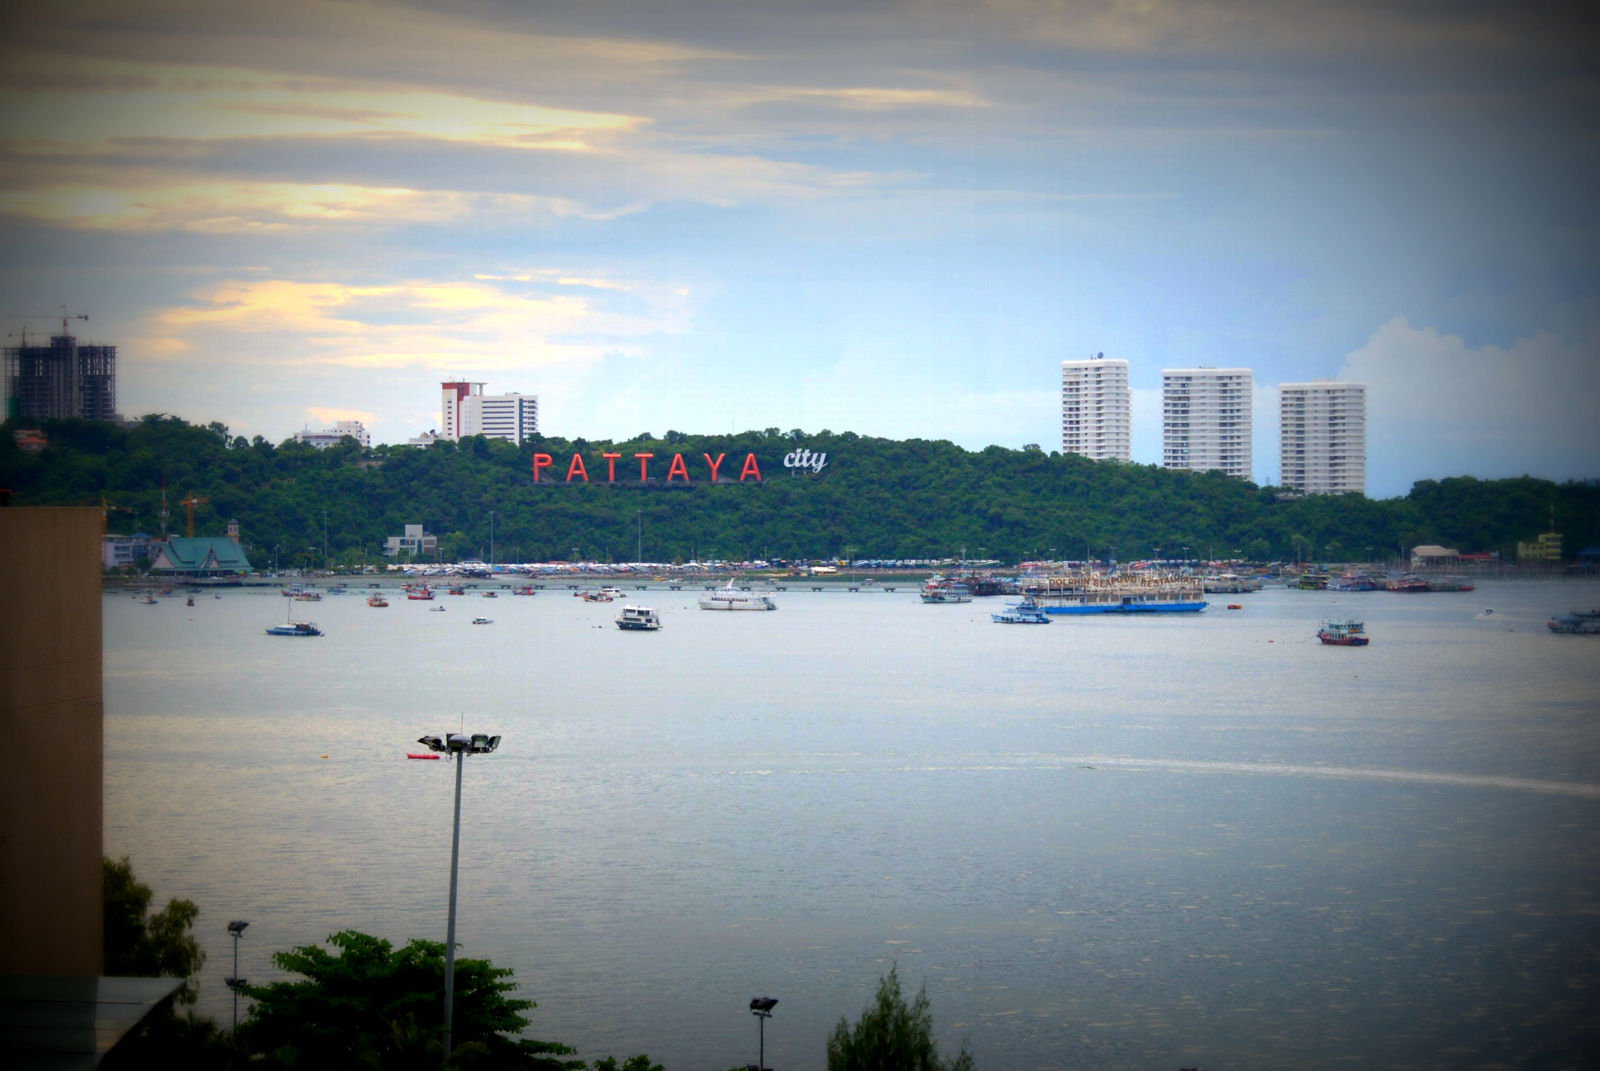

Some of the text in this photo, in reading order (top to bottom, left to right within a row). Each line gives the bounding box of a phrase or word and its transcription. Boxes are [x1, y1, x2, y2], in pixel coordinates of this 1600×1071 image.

[532, 448, 827, 483] PATTAYA city
[1049, 577, 1090, 586] DOLPHIN
